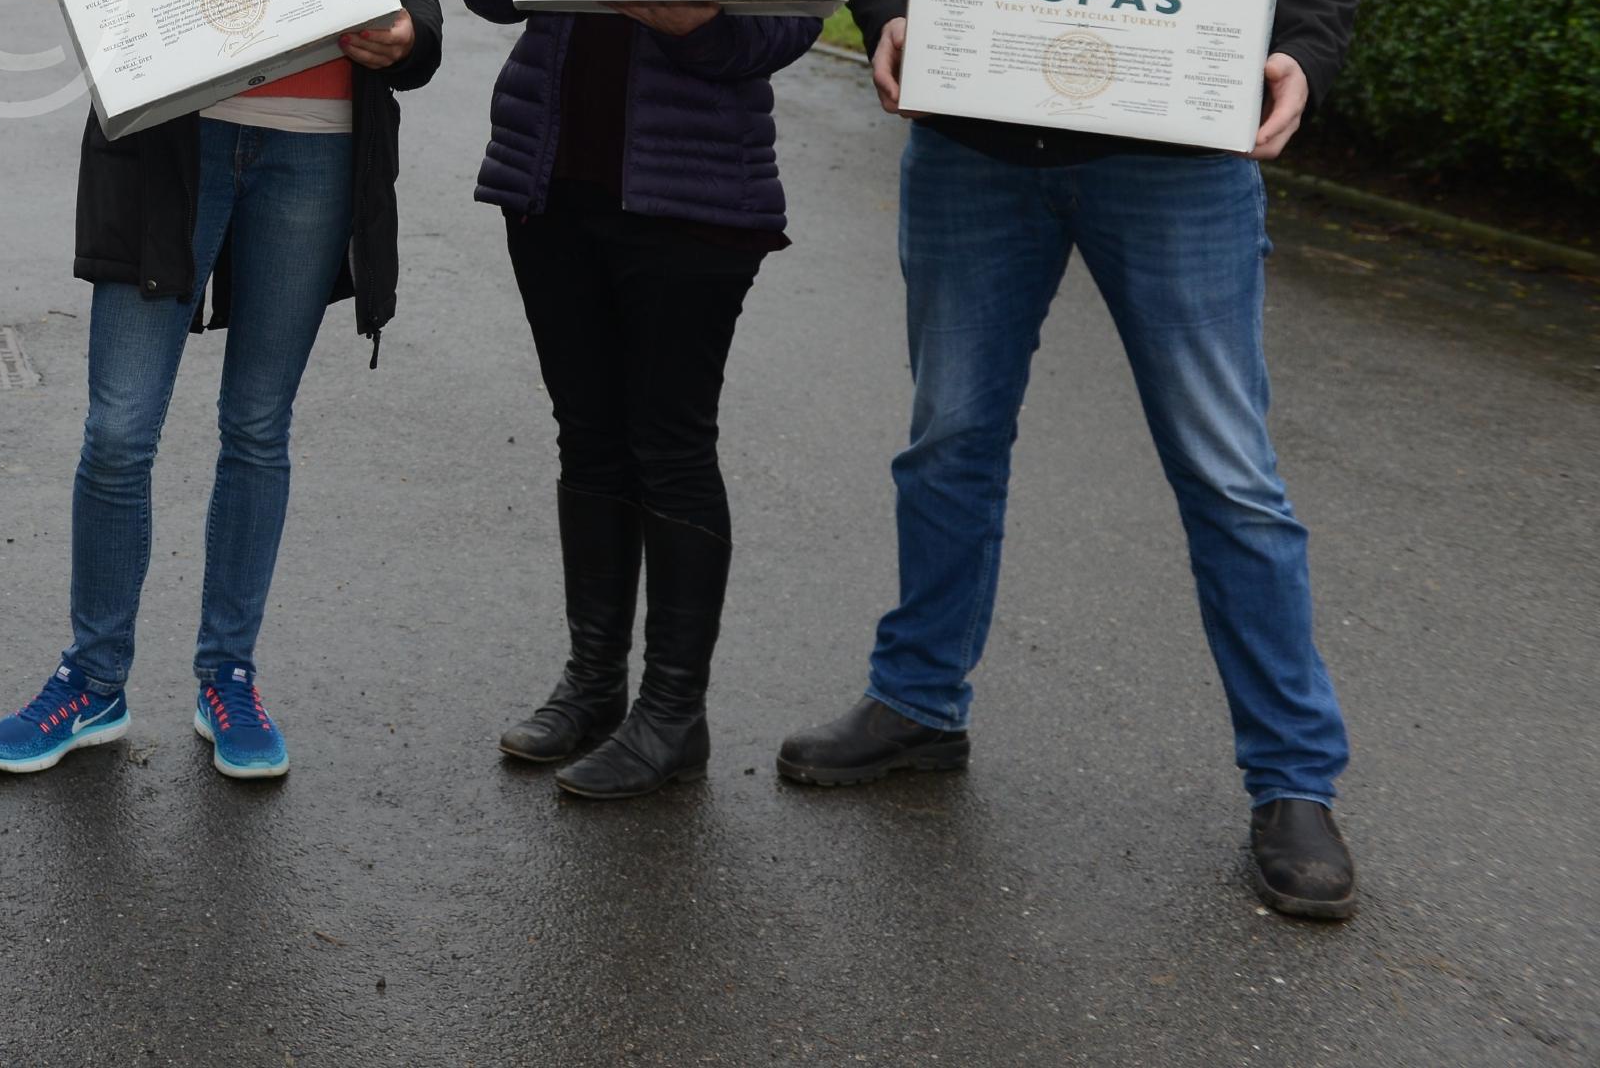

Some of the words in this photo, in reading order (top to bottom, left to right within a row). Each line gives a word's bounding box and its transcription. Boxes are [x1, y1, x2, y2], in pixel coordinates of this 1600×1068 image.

[994, 0, 1026, 12] VERY
[1030, 3, 1061, 16] VERY
[1065, 7, 1116, 22] SPECIAL
[1120, 13, 1177, 28] TURKEYS
